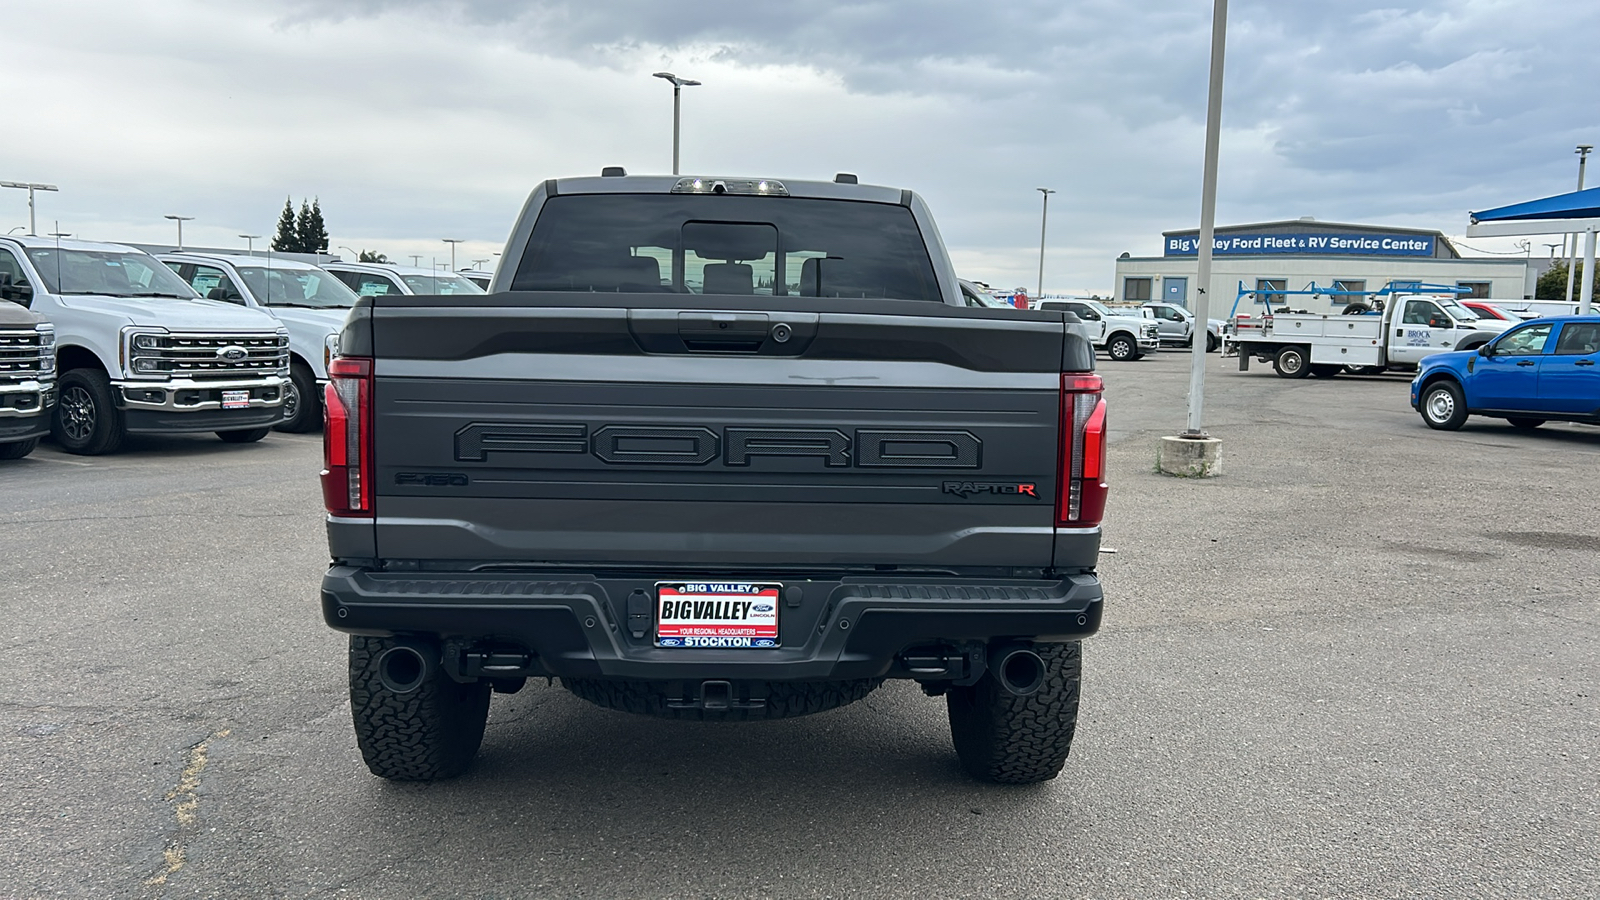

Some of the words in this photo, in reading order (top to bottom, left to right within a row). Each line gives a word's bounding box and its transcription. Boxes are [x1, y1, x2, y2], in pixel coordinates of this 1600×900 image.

[1169, 239, 1190, 251] Big
[1192, 239, 1231, 251] Vley
[1232, 237, 1262, 249] Ford
[1263, 237, 1297, 248] Fleet
[1298, 238, 1306, 248] &
[1308, 237, 1328, 248] RV
[1329, 237, 1380, 249] Service
[1381, 238, 1429, 251] Center
[1407, 330, 1431, 338] BROCK
[454, 421, 983, 469] FORD
[394, 472, 469, 486] F-150
[942, 481, 1041, 500] RAPTOR
[686, 584, 707, 593] BIG
[709, 584, 752, 593] VALLEY
[661, 600, 752, 620] BIGVALLEY
[755, 604, 770, 612] Ford
[718, 628, 756, 636] HEADQUARTERS
[684, 637, 752, 647] STOCKTON
